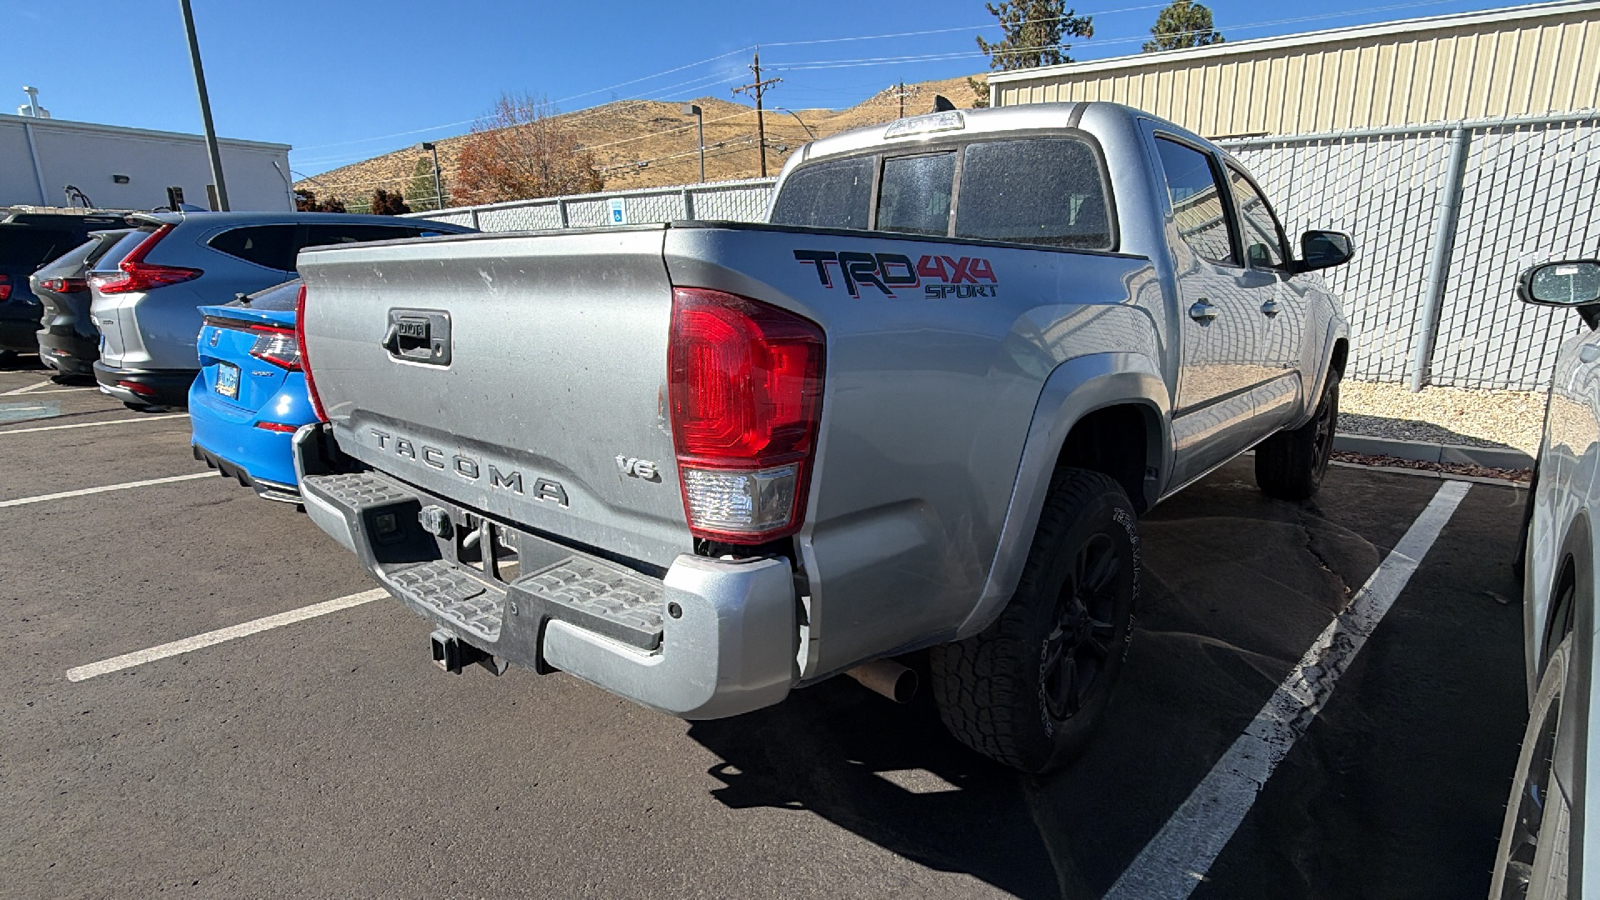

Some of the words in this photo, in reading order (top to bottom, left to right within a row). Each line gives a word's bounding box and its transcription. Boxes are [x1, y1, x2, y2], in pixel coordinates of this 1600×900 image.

[793, 249, 920, 299] TRD
[925, 284, 998, 299] SPORT
[370, 428, 570, 509] TACOMA
[615, 453, 660, 481] V6
